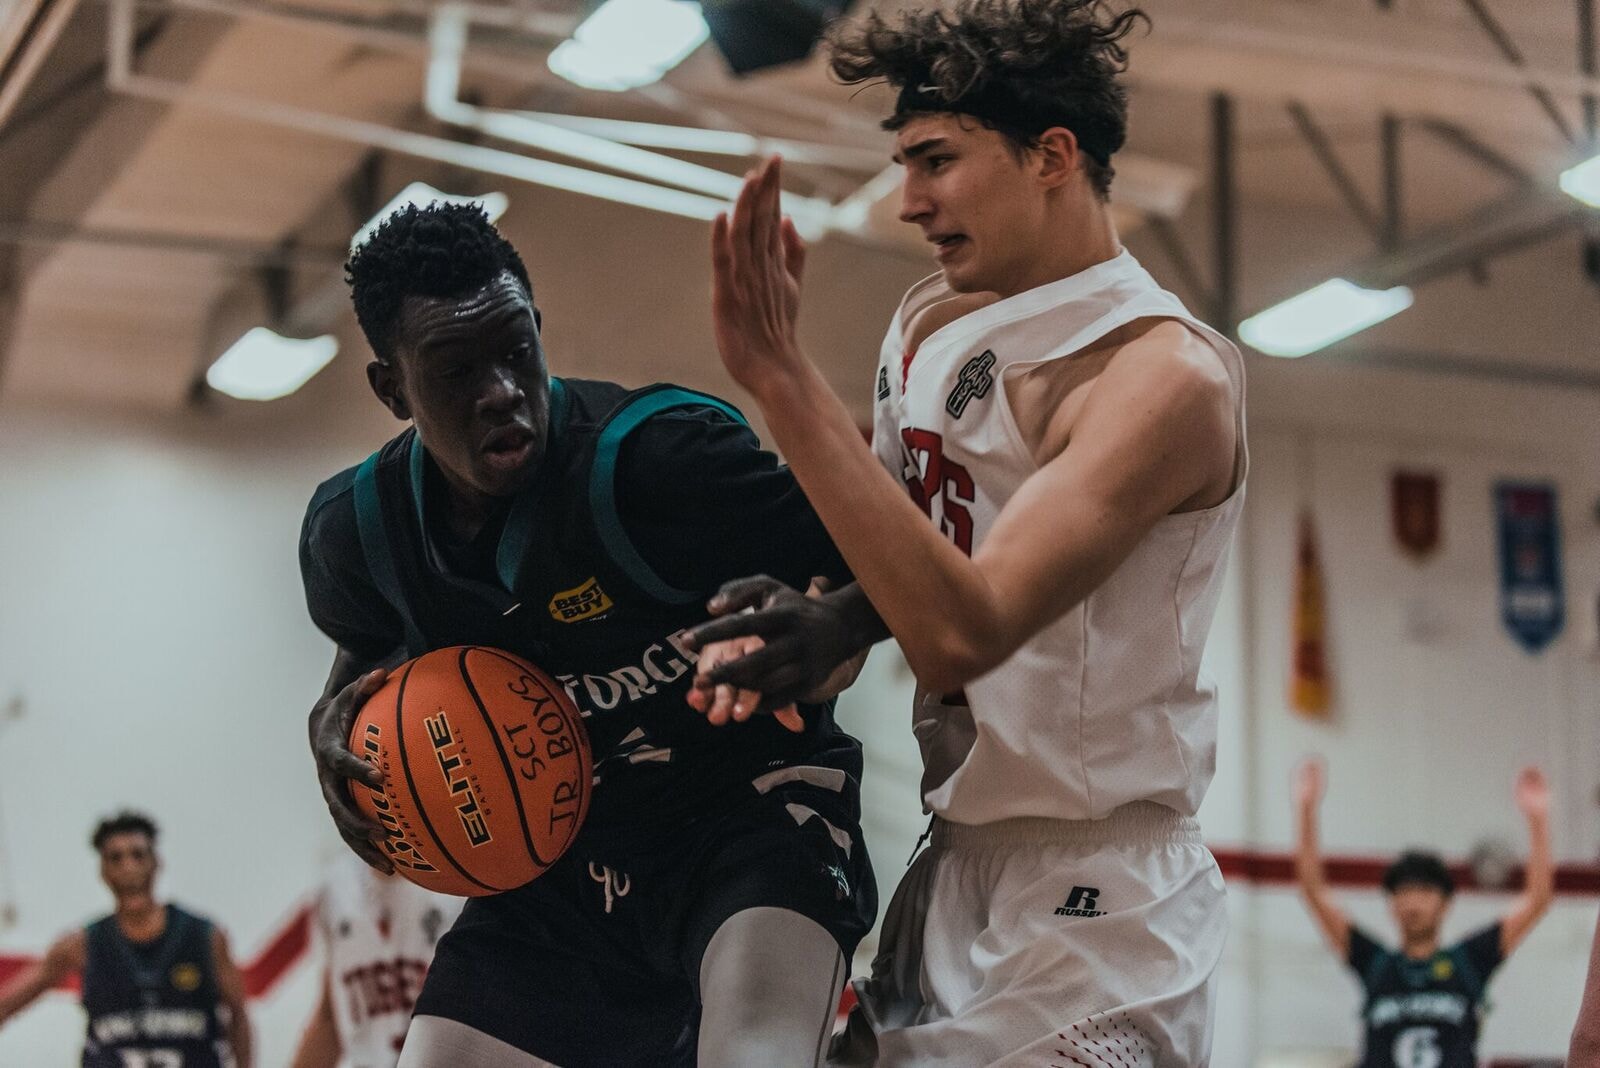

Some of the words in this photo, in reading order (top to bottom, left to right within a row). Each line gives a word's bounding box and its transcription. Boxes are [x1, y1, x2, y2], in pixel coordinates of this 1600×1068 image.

[554, 583, 601, 609] BEST
[561, 594, 603, 618] BUY
[507, 675, 573, 759] BOYS
[454, 728, 472, 765] BALL
[503, 724, 545, 781] SCT
[424, 711, 493, 848] ELITE
[471, 775, 492, 816] GAME
